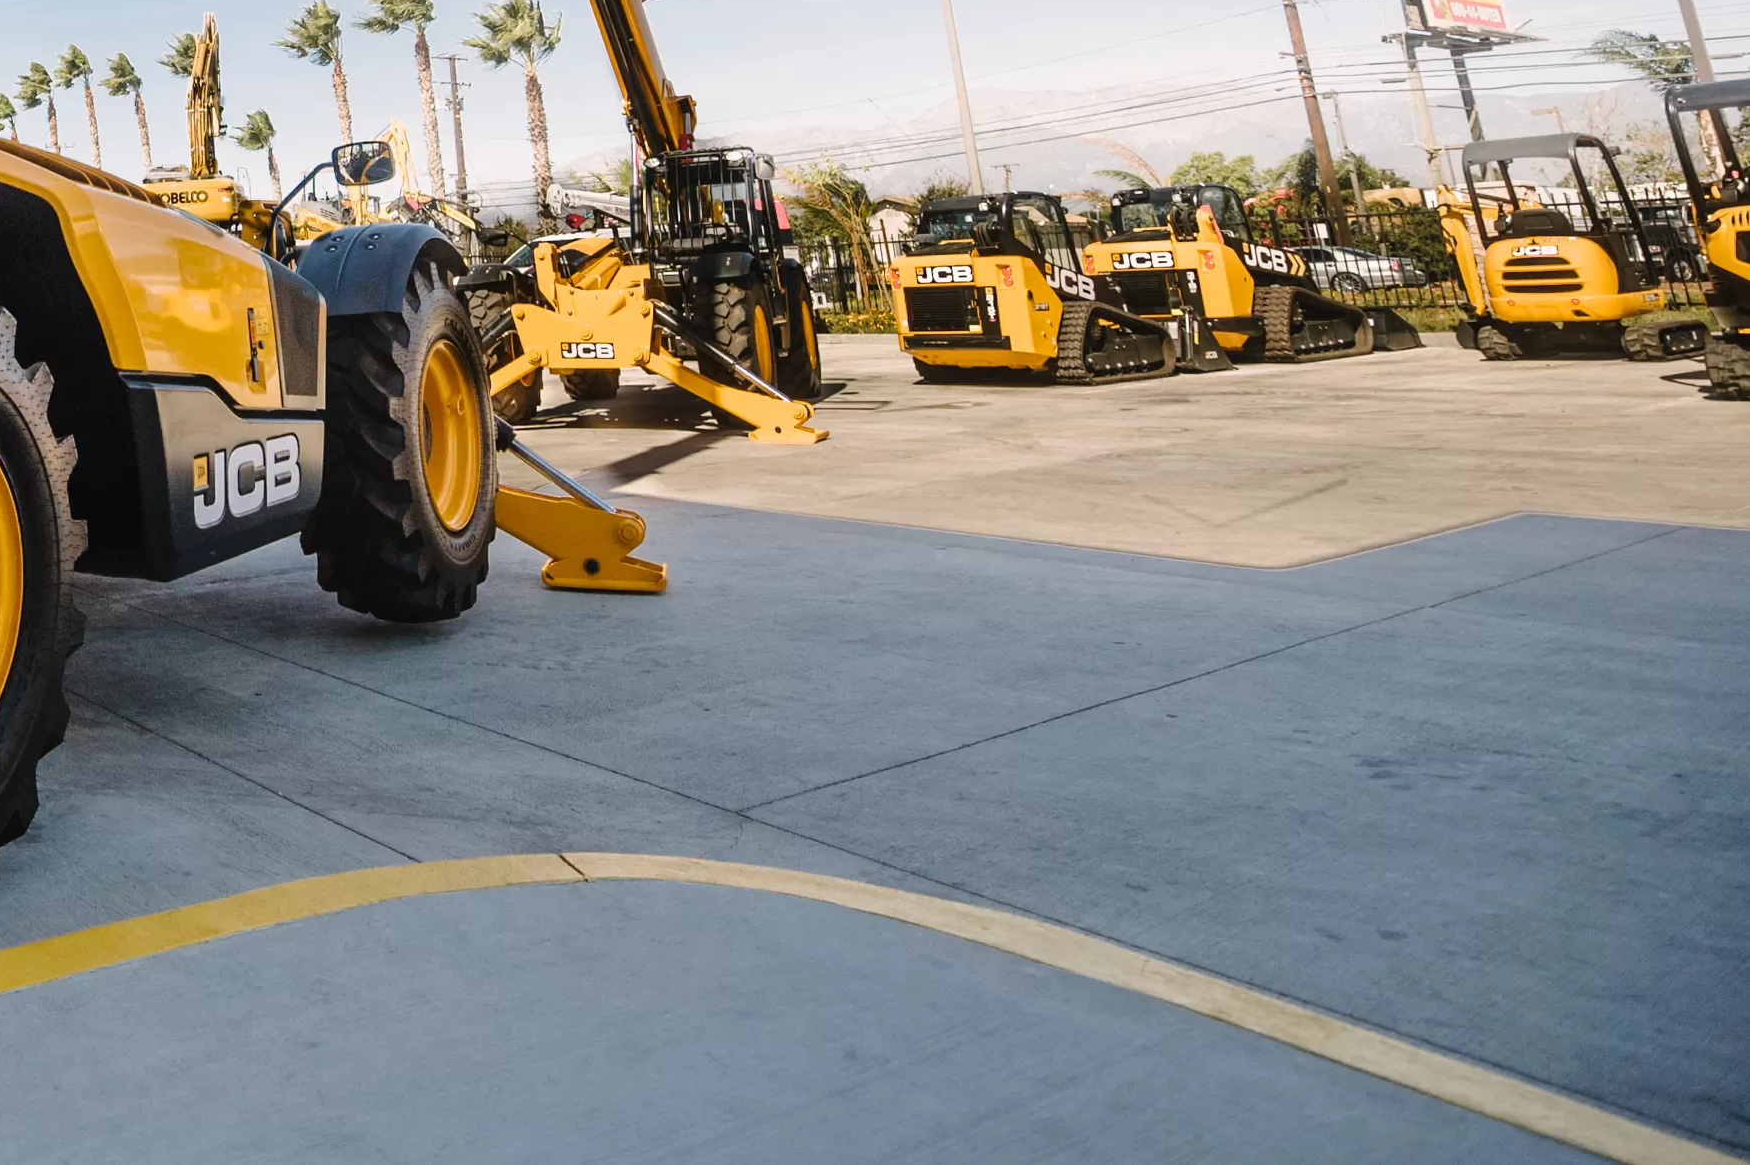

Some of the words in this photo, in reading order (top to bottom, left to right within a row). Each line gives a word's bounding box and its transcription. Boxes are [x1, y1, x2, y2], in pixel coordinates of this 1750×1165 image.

[158, 190, 208, 204] OBELCO
[1244, 244, 1288, 273] JCB
[1512, 245, 1558, 256] JCB
[1113, 252, 1174, 269] JCB
[917, 266, 973, 284] JCB
[1046, 266, 1096, 301] JCB
[562, 343, 615, 358] JCB
[1204, 351, 1218, 359] JCB
[193, 432, 302, 529] JCB
